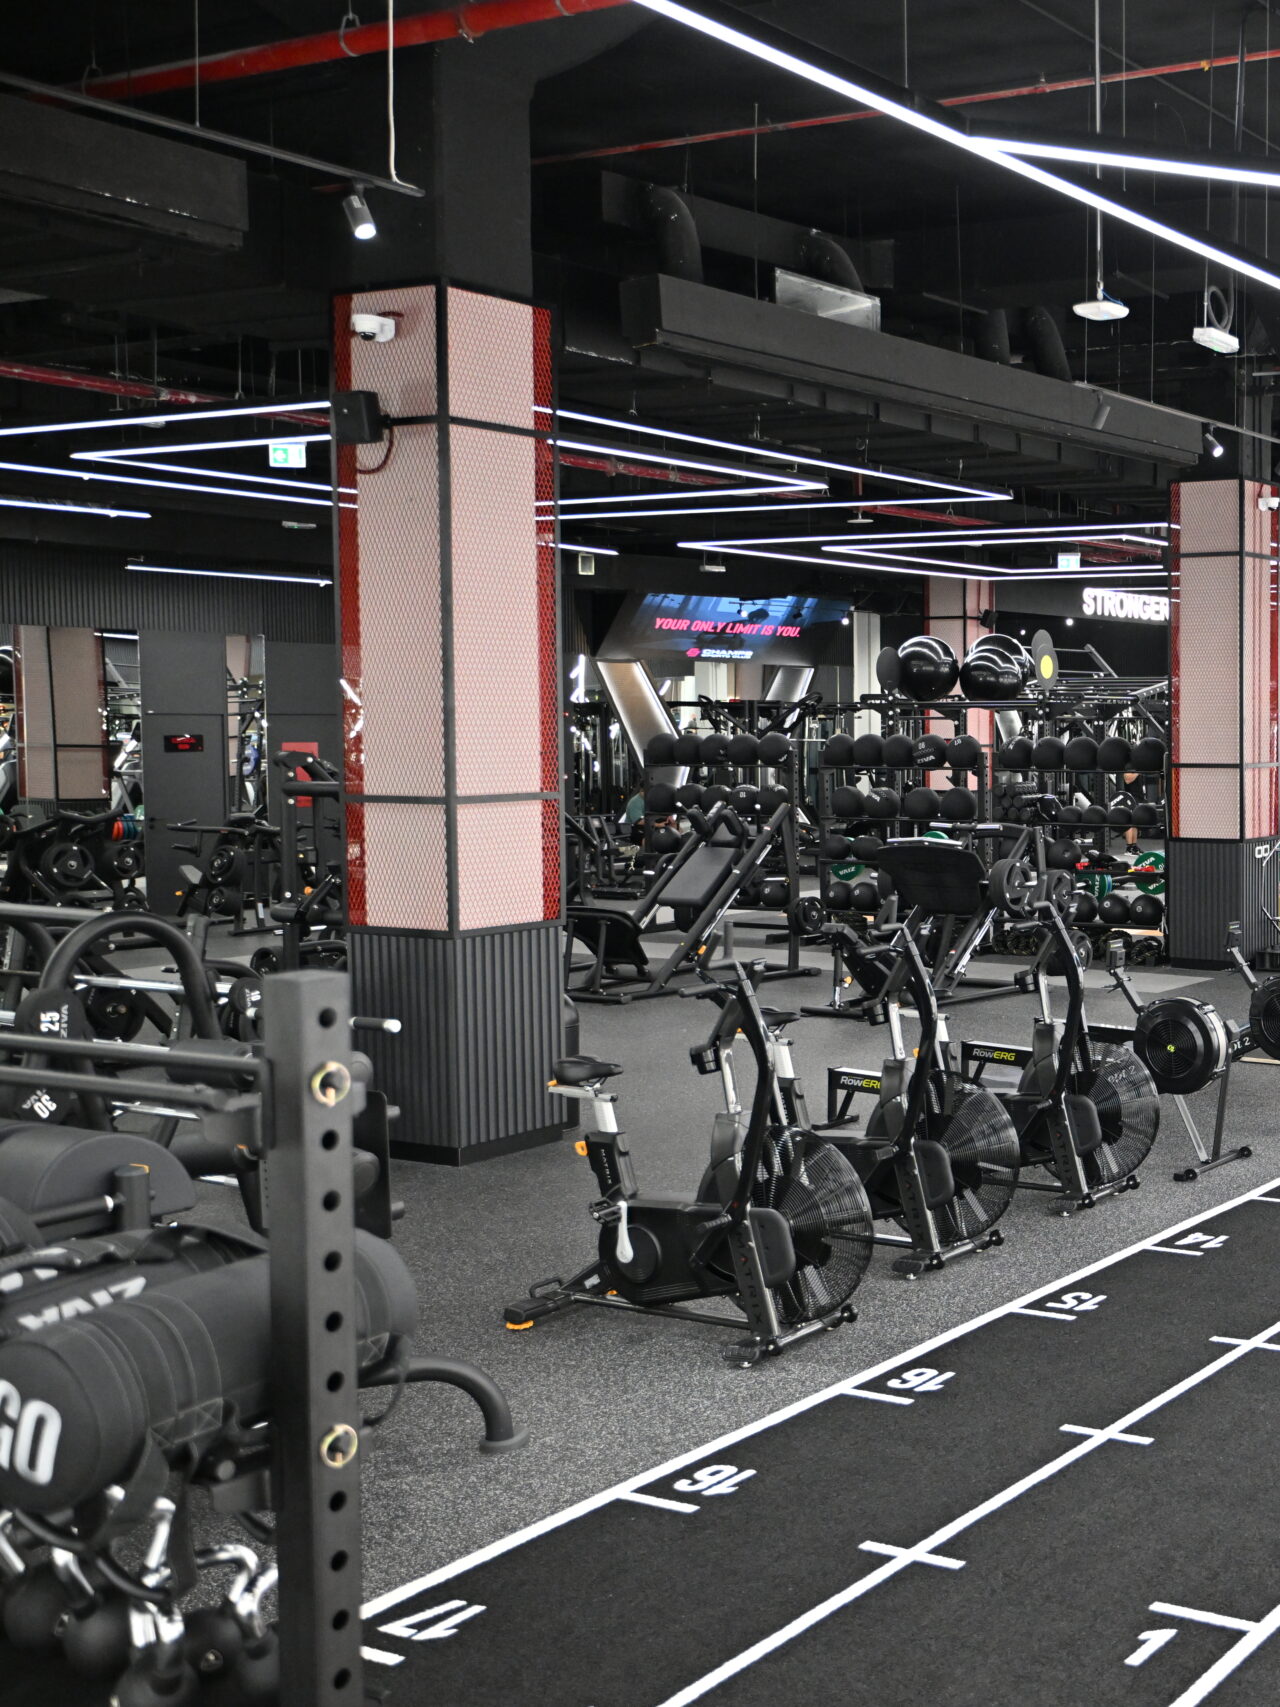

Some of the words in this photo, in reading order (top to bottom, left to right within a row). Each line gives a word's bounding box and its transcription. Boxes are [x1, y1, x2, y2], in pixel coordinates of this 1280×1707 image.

[1083, 587, 1169, 621] STRONGER
[655, 617, 689, 630] YOUR
[691, 620, 724, 633] ONLY
[726, 622, 758, 634] LIMIT
[761, 624, 773, 635] IS
[775, 626, 800, 638] YOU.
[839, 866, 855, 875] ZIVA
[40, 1011, 60, 1033] 25
[60, 1004, 69, 1038] ZIVA
[972, 1047, 1016, 1061] RowERG
[33, 1093, 57, 1120] 30
[601, 1148, 612, 1184] MATRIX
[1174, 1232, 1230, 1249] 14
[1045, 1291, 1108, 1312] 15
[886, 1368, 956, 1392] 16
[673, 1464, 757, 1496] 16
[376, 1599, 487, 1640] 17
[1123, 1628, 1178, 1667] 1
